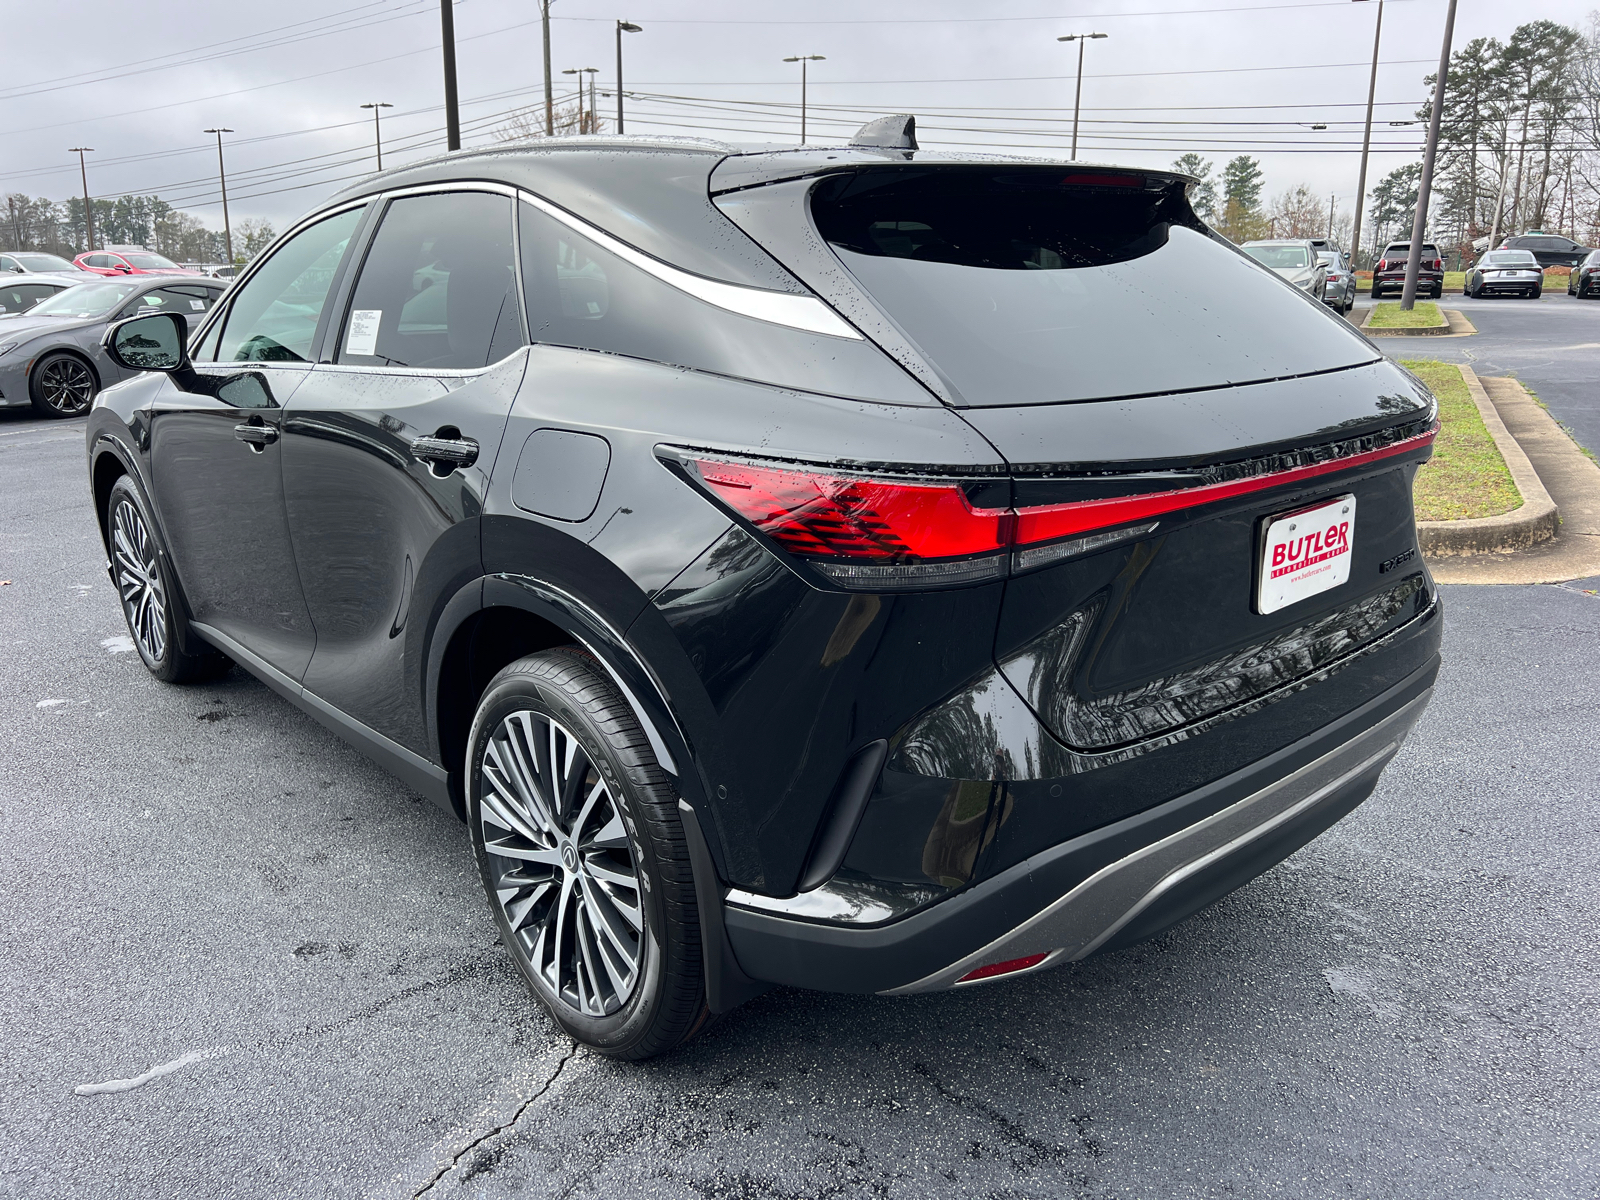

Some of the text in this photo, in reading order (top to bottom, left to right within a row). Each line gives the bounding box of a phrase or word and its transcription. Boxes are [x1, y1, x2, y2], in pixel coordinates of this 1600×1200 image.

[1271, 545, 1349, 579] AUTOMOTIVE GROUP
[1291, 564, 1332, 583] www.butlercars.com
[560, 707, 651, 894] GOODYEAR
